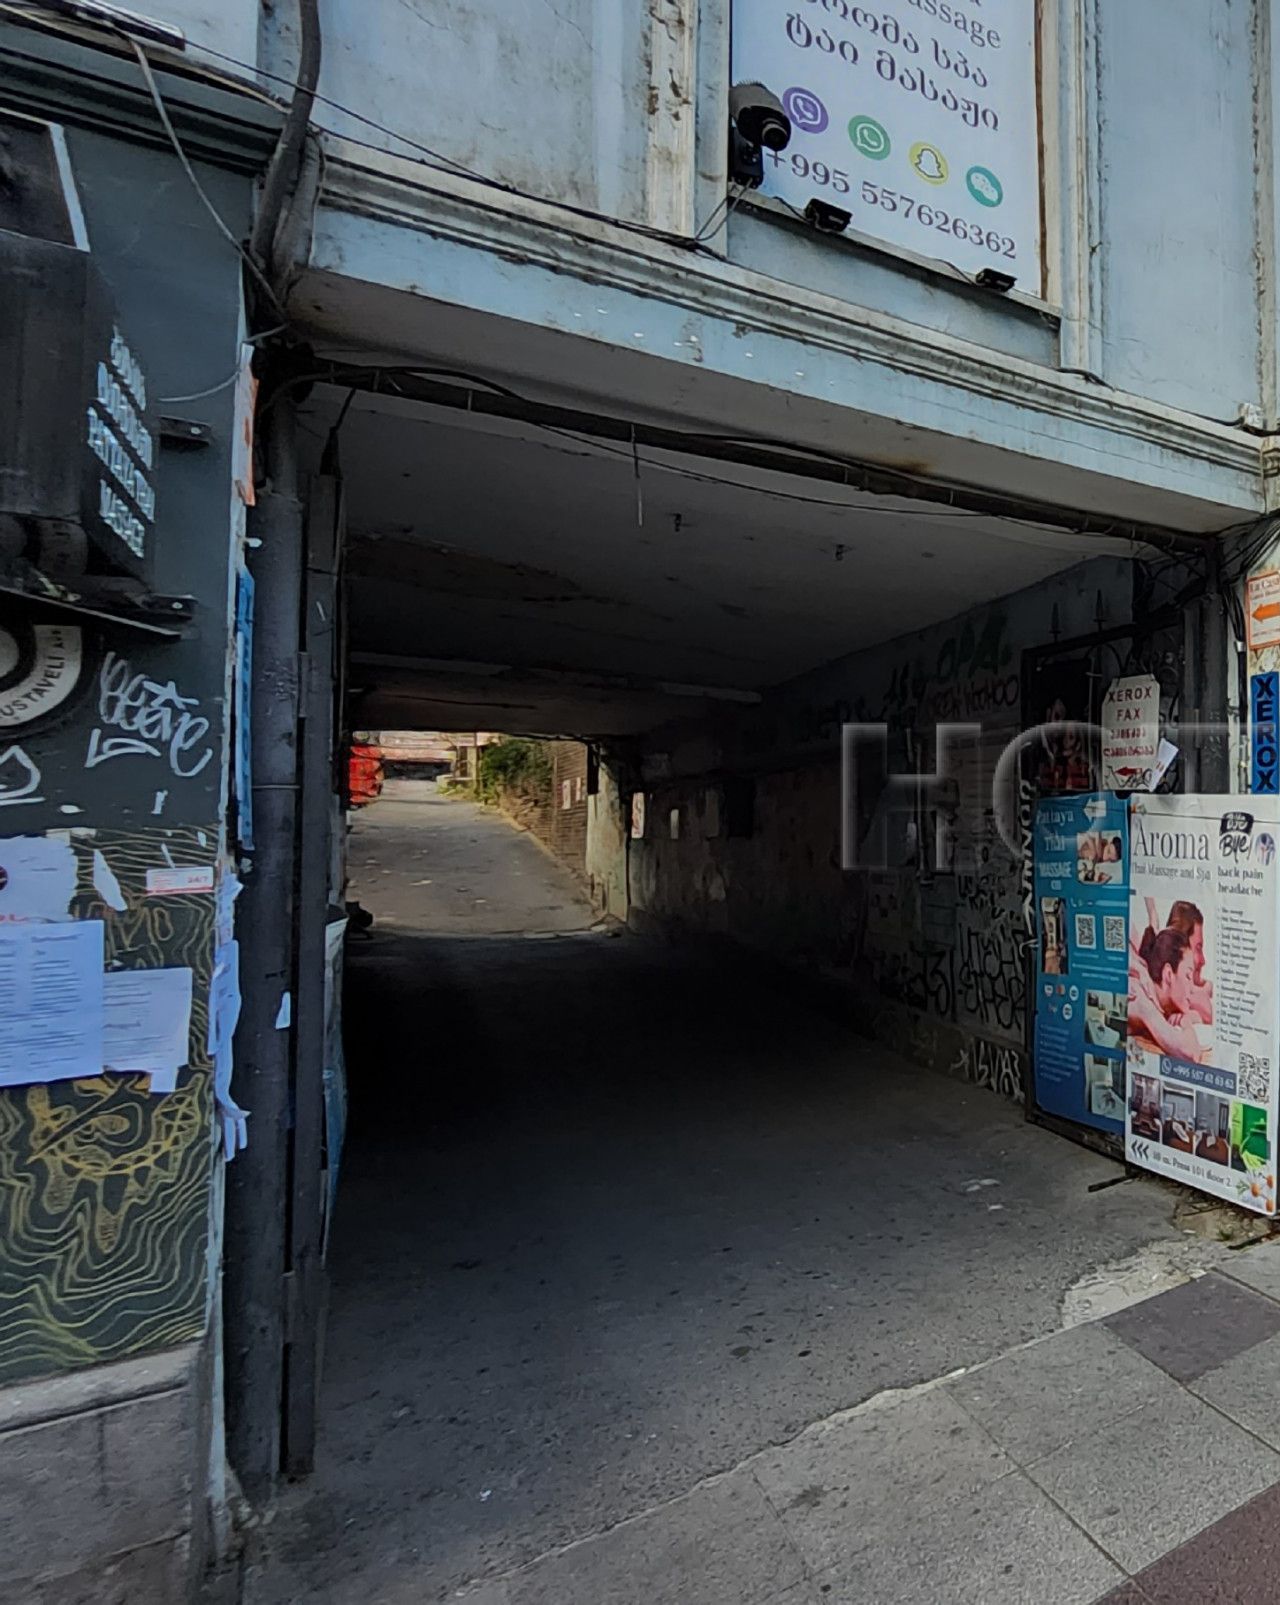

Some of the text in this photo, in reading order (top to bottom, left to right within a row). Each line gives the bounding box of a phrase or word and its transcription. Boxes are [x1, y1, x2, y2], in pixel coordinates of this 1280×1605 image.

[808, 0, 988, 88] რომა სპა
[908, 0, 1001, 49] ssage
[786, 12, 999, 131] ტაი მასაჟი
[766, 150, 1017, 259] +995 557626362
[0, 655, 65, 718] USTAVELI
[1108, 686, 1152, 704] XEROX
[1116, 708, 1141, 722] FAX
[1255, 676, 1277, 791] XEROX
[1133, 818, 1210, 861] Aroma
[1148, 863, 1179, 879] Massage
[1180, 866, 1194, 880] and
[1218, 865, 1263, 881] back pain
[1218, 882, 1263, 896] headache
